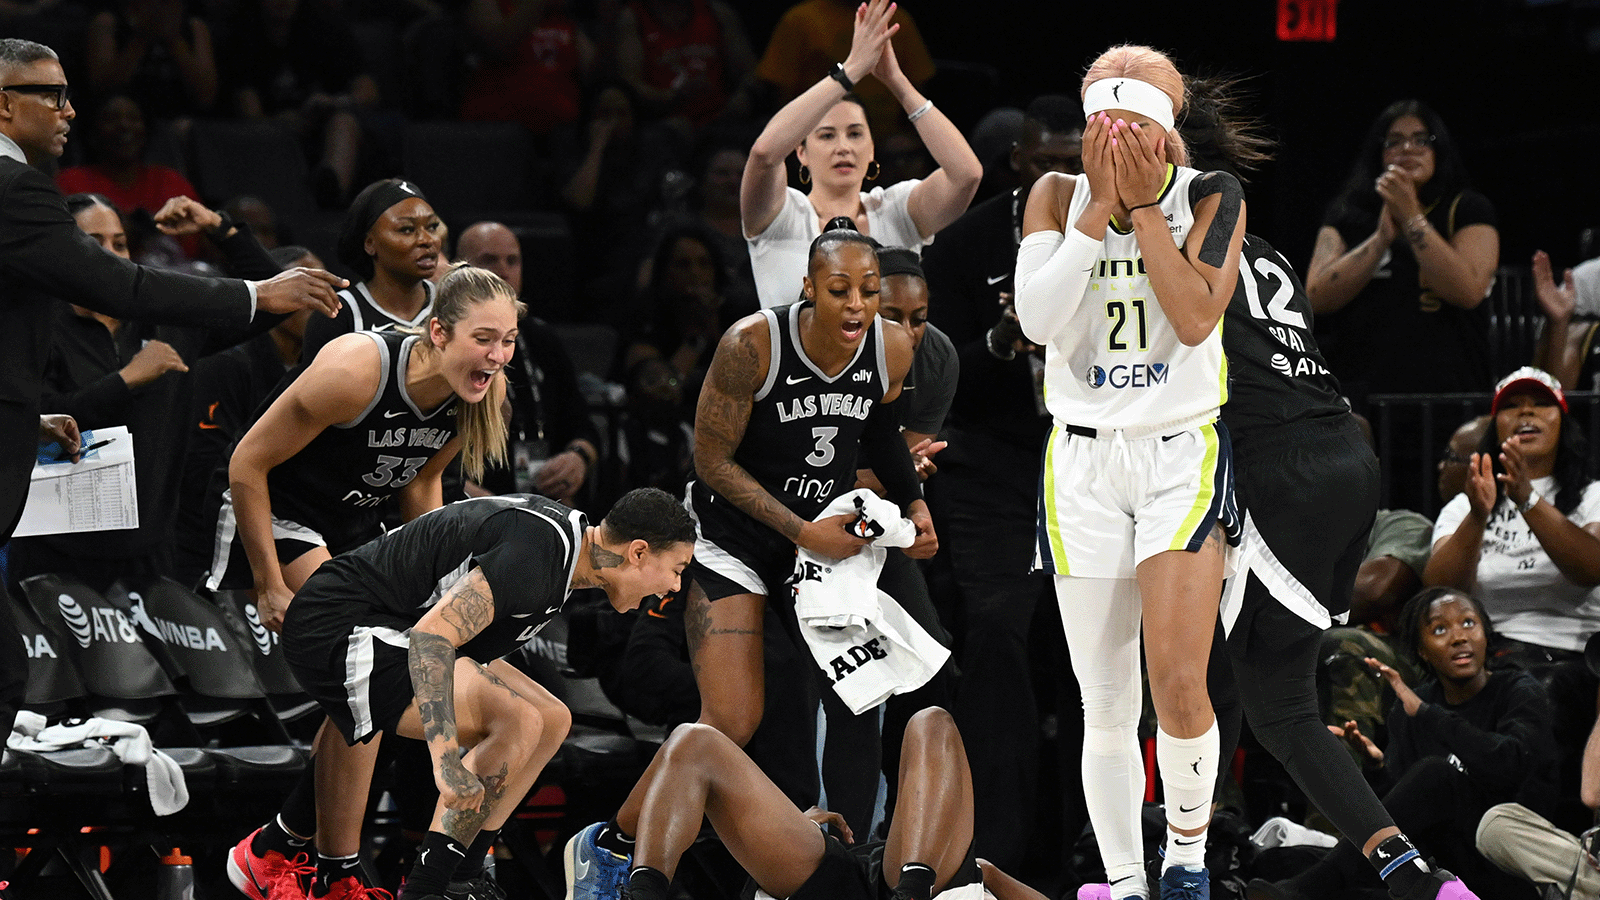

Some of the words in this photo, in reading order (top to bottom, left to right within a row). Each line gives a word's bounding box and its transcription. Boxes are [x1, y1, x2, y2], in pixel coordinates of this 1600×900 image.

[1239, 251, 1308, 329] 12
[1105, 298, 1149, 352] 21
[852, 369, 873, 384] ally
[1108, 363, 1170, 389] GEM
[776, 395, 818, 423] LAS
[819, 393, 873, 421] VEGAS
[368, 427, 407, 448] LAS
[805, 426, 839, 467] 3
[361, 454, 428, 488] 33
[783, 474, 835, 503] ring
[154, 617, 228, 652] WNBA
